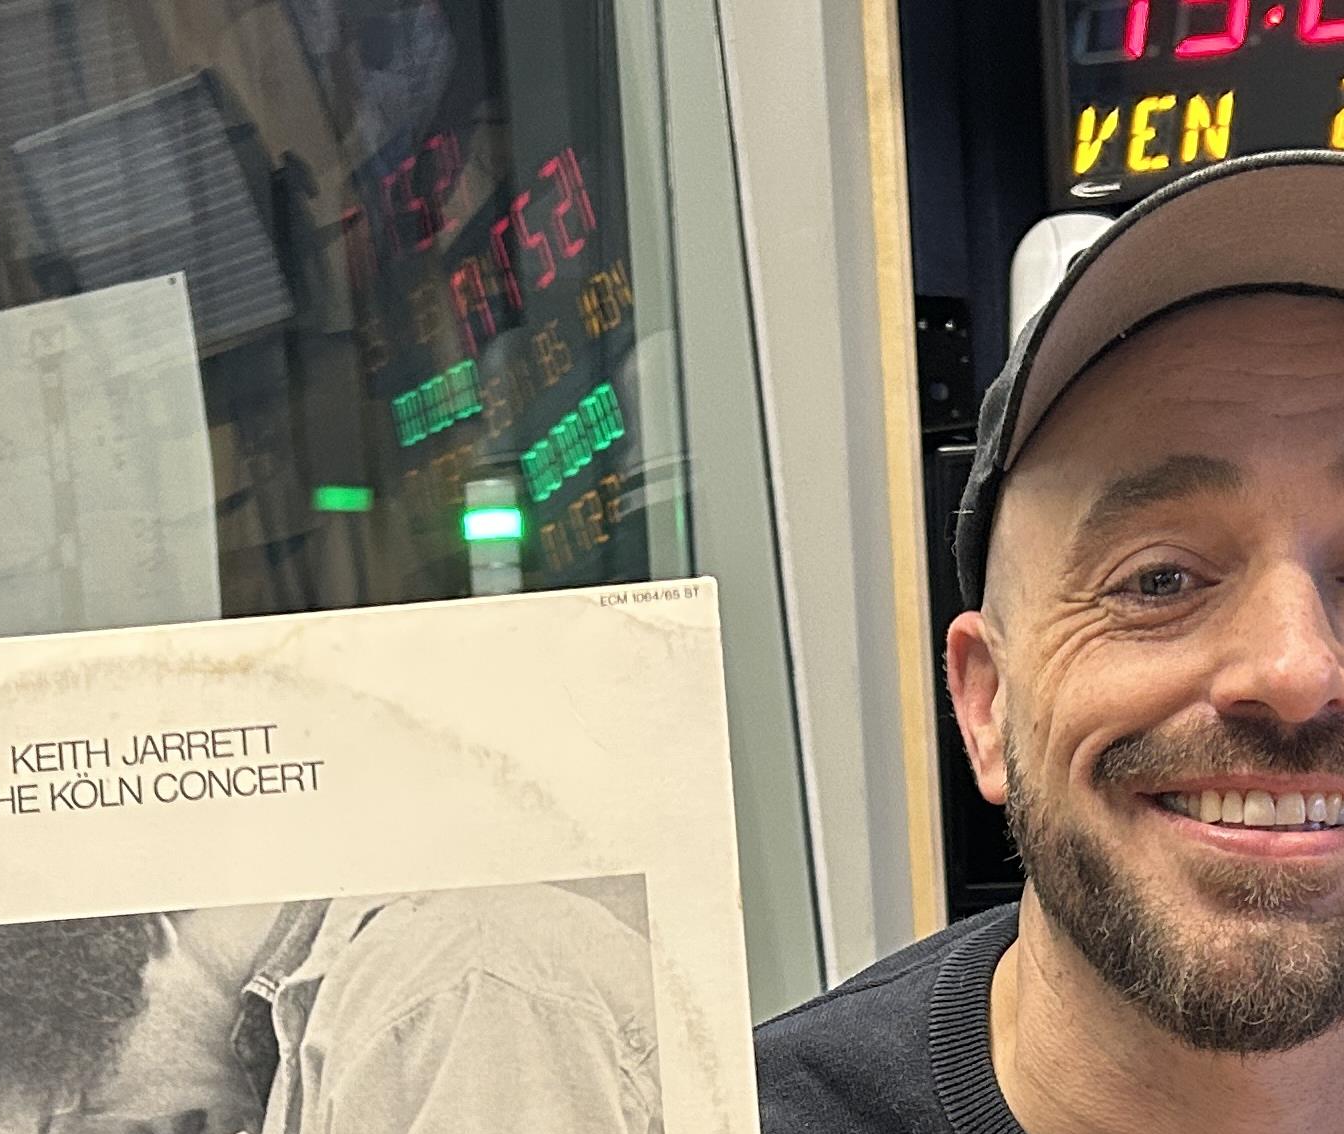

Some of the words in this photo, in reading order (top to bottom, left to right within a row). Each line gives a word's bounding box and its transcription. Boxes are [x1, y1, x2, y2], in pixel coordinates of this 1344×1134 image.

[1073, 90, 1234, 174] VEN
[599, 591, 628, 607] ECM
[10, 737, 111, 775] KEITH
[121, 724, 279, 767] JARRETT
[49, 772, 144, 812] KÖLN
[153, 760, 326, 804] CONCERT
